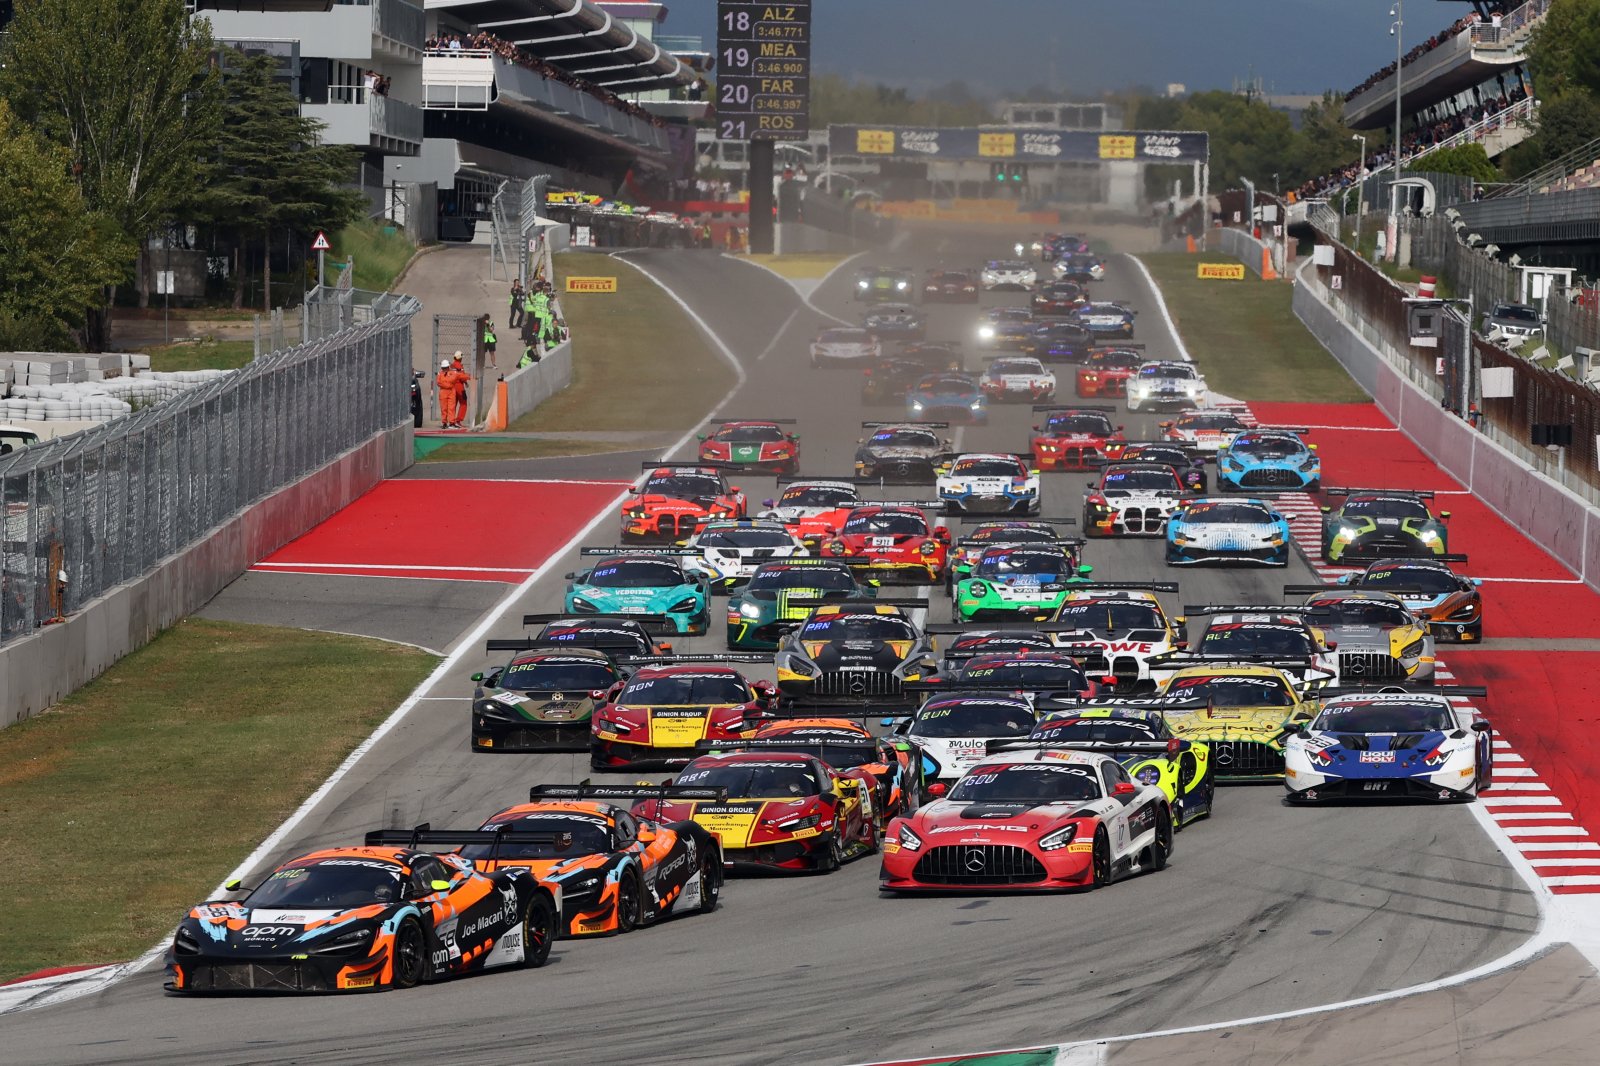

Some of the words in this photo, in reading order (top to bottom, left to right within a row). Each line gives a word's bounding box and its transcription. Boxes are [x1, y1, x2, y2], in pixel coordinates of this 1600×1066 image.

[763, 8, 795, 20] ALZ
[724, 12, 750, 31] 18
[758, 27, 802, 37] 3:46.771
[761, 44, 796, 56] MEA
[724, 48, 749, 67] 19
[758, 64, 802, 73] 3:46.900
[762, 80, 794, 93] FAR
[722, 84, 748, 104] 20
[760, 116, 794, 128] ROS
[722, 120, 746, 138] 21
[1144, 136, 1181, 146] GRAND
[1202, 267, 1240, 276] PIRELLI
[570, 280, 612, 290] PIRELLI
[1096, 600, 1156, 608] WORLD
[1342, 599, 1400, 609] WORLD
[1062, 606, 1088, 616] FAR
[845, 614, 903, 623] WORLD
[580, 628, 640, 636] WORLD
[736, 623, 748, 642] 7
[1242, 624, 1304, 632] WORLD
[1206, 631, 1232, 641] ALZ
[544, 657, 608, 665] WORLD
[509, 664, 537, 674] GAC
[968, 668, 994, 678] VER
[626, 680, 654, 694] BON
[1210, 678, 1279, 688] WORLD
[960, 700, 1030, 710] WORLD
[921, 709, 952, 720] BUN
[1322, 706, 1354, 716] BOR
[1076, 720, 1150, 730] WORLD
[792, 730, 866, 738] WORLD
[1008, 765, 1088, 776] WORLD
[678, 770, 710, 784] ABR
[1363, 782, 1390, 790] GRT
[526, 814, 608, 825] WORLD
[796, 828, 816, 838] PIRELLI
[956, 824, 1028, 832] AMG
[320, 860, 402, 872] WORLD
[272, 868, 305, 881] MAC
[462, 924, 476, 939] Joe
[478, 907, 503, 930] Macari
[580, 924, 600, 932] PIRELLI
[502, 933, 520, 949] MOUSE
[346, 978, 374, 988] PIRELLI
